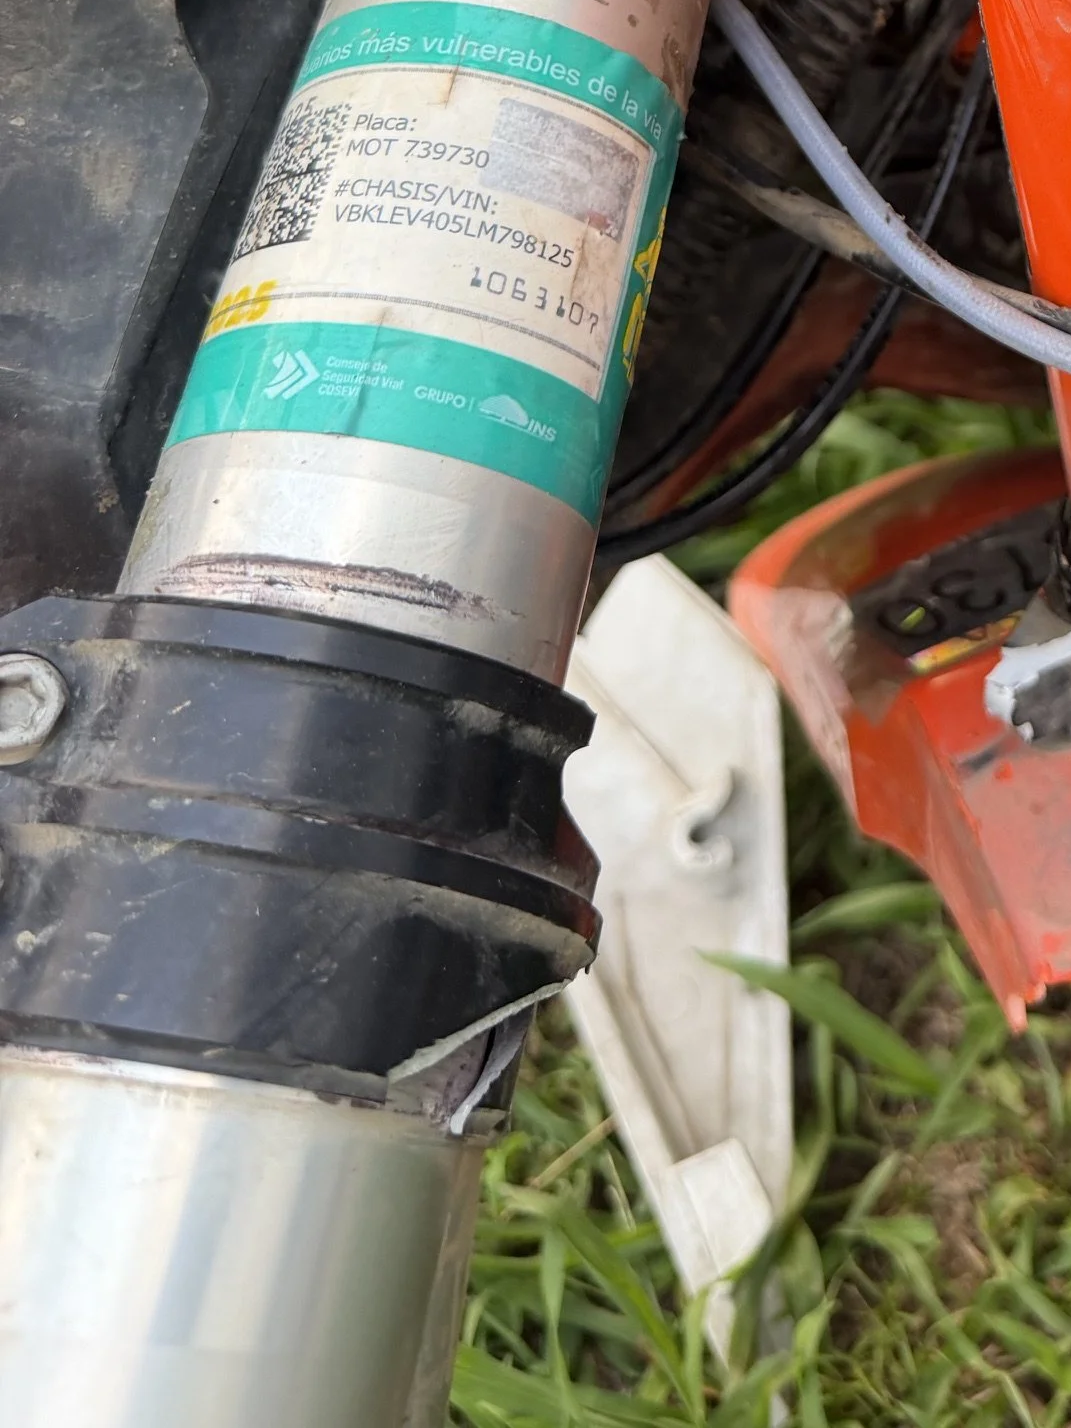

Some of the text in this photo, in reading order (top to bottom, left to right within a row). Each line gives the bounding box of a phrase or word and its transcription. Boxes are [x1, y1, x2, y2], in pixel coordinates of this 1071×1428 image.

[358, 31, 411, 55] más
[422, 34, 581, 86] vulnerables
[588, 76, 617, 102] de
[621, 90, 638, 118] la
[353, 113, 418, 132] Placa:
[346, 138, 490, 169] MOT 739730
[335, 178, 499, 215] #CHASIS/VIN:
[335, 204, 575, 268] VBKLEV405LM798125
[372, 361, 388, 373] de
[413, 385, 557, 442] GRUPO INS
